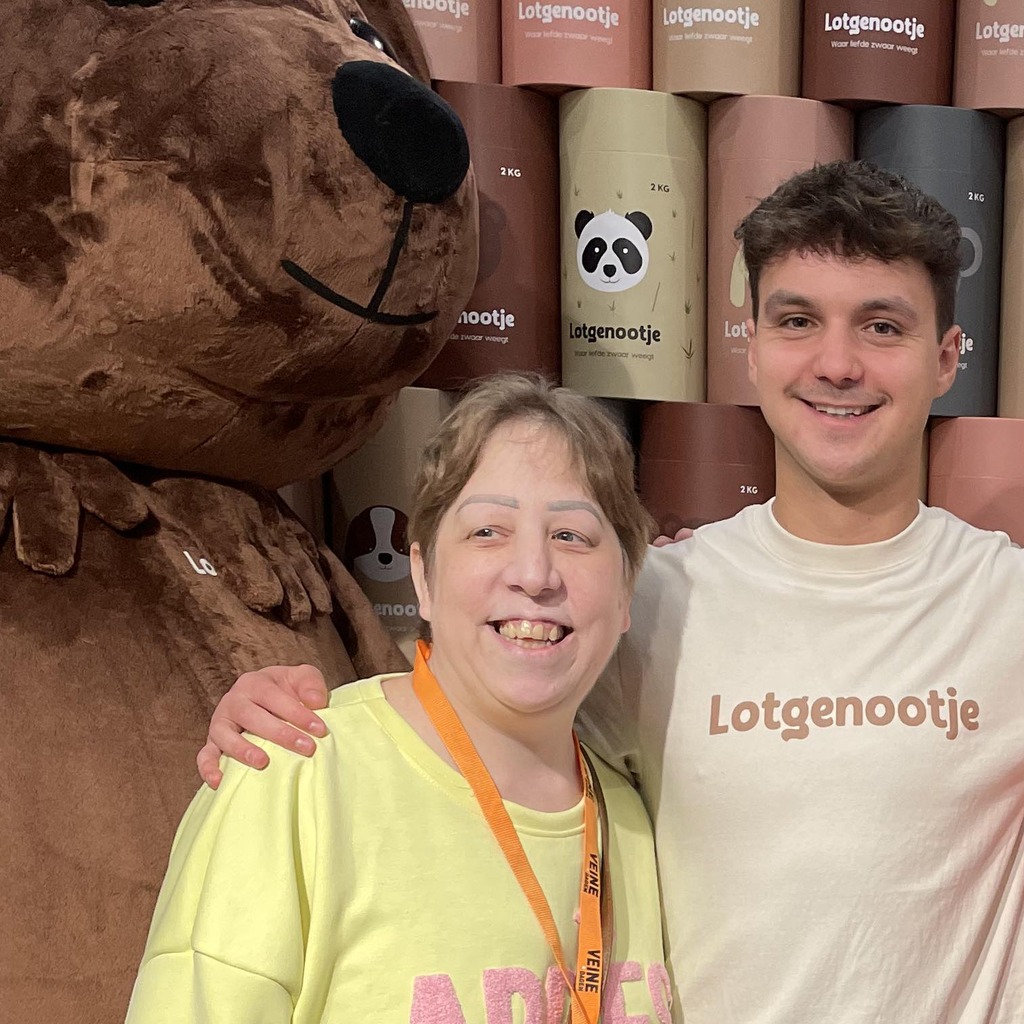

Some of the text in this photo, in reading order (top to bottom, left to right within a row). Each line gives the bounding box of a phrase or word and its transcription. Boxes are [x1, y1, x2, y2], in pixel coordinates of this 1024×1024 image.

[518, 1, 619, 29] Lotgenootje
[663, 6, 760, 29] Lotgenootje
[824, 12, 925, 41] Lotgenootje
[831, 40, 849, 48] Waar
[507, 168, 521, 177] KG
[658, 184, 670, 192] KG
[974, 193, 985, 202] KG
[569, 322, 661, 345] Lotgenootje
[746, 486, 758, 494] KG
[709, 686, 980, 742] Lotgenootje
[588, 853, 599, 897] VEINE
[585, 950, 601, 994] VEINE
